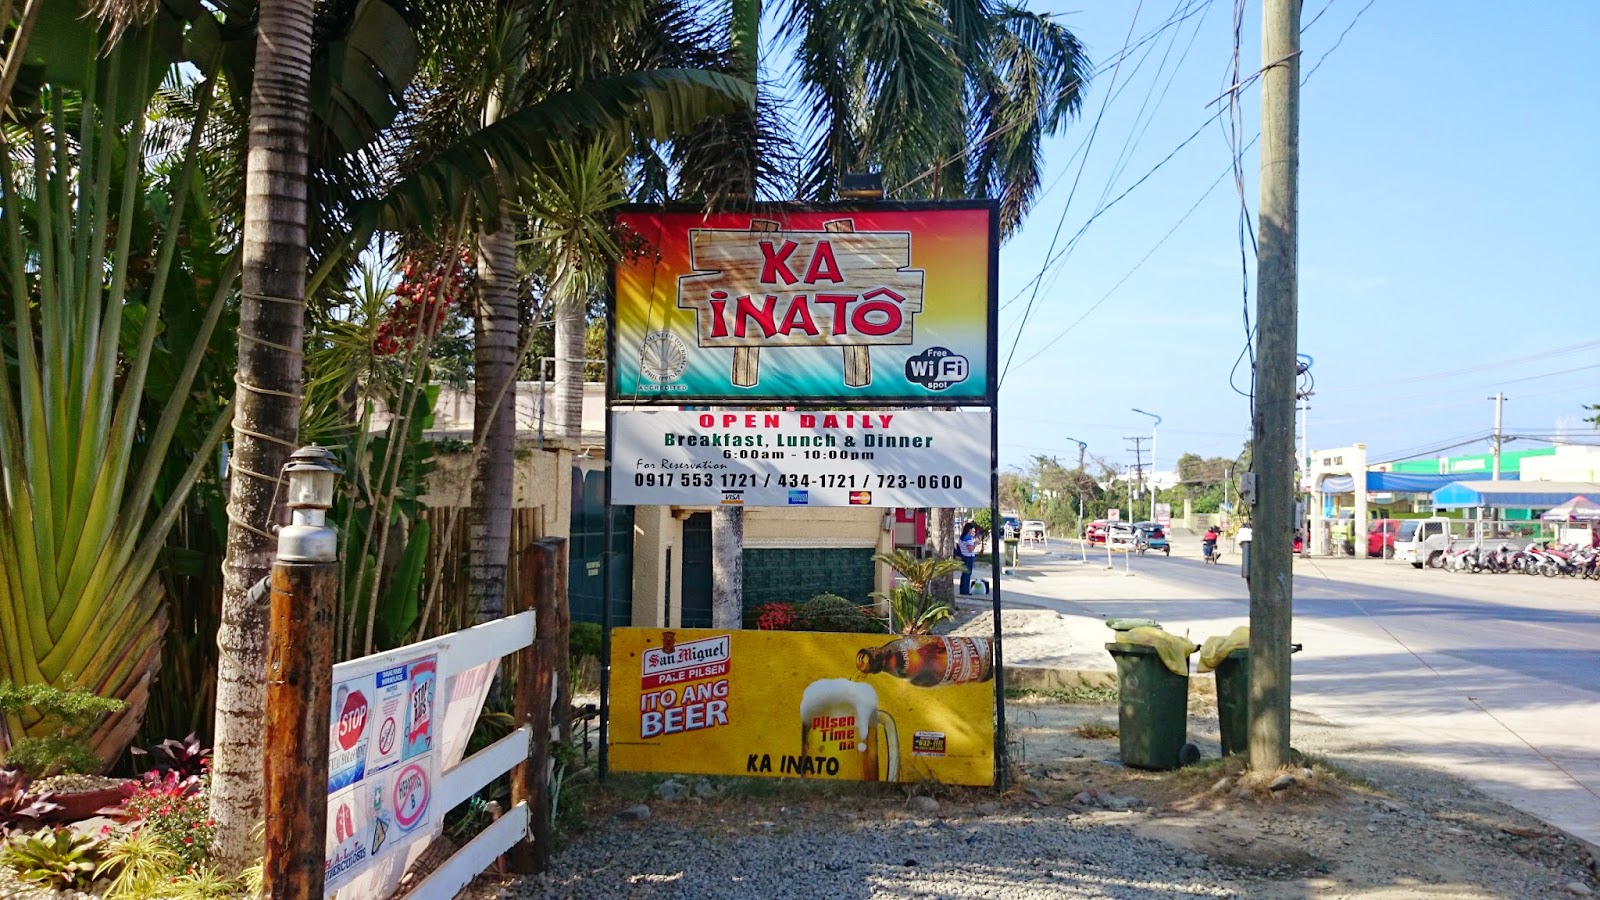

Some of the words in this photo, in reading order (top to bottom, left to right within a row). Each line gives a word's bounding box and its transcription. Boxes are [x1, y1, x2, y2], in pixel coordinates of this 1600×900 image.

[758, 240, 844, 284] KA
[927, 349, 947, 357] Free
[927, 381, 948, 390] spot
[699, 414, 780, 429] OPEN
[800, 414, 893, 429] DAILY
[664, 433, 769, 448] Breakfast,
[777, 433, 836, 448] Lunch
[844, 435, 857, 448] &
[864, 433, 933, 448] Dinner
[723, 449, 785, 459] 6:00am
[804, 450, 874, 461] 10:00pm
[636, 458, 656, 469] For
[661, 458, 728, 470] Reservation
[634, 472, 674, 487] 0917
[681, 473, 714, 487] 553
[720, 473, 757, 487] 1721
[778, 474, 855, 488] 434-1721
[877, 474, 963, 489] 723-0600
[649, 653, 676, 668] San
[676, 641, 724, 664] Miguel
[658, 671, 686, 684] PALE
[688, 664, 726, 679] PILSEN
[641, 689, 677, 712] ITO
[681, 679, 729, 704] ANG
[340, 704, 367, 737] STOP
[641, 700, 729, 739] BEER
[820, 729, 855, 742] Time
[839, 741, 855, 751] na
[747, 754, 772, 773] KA
[780, 755, 839, 776] INATO
